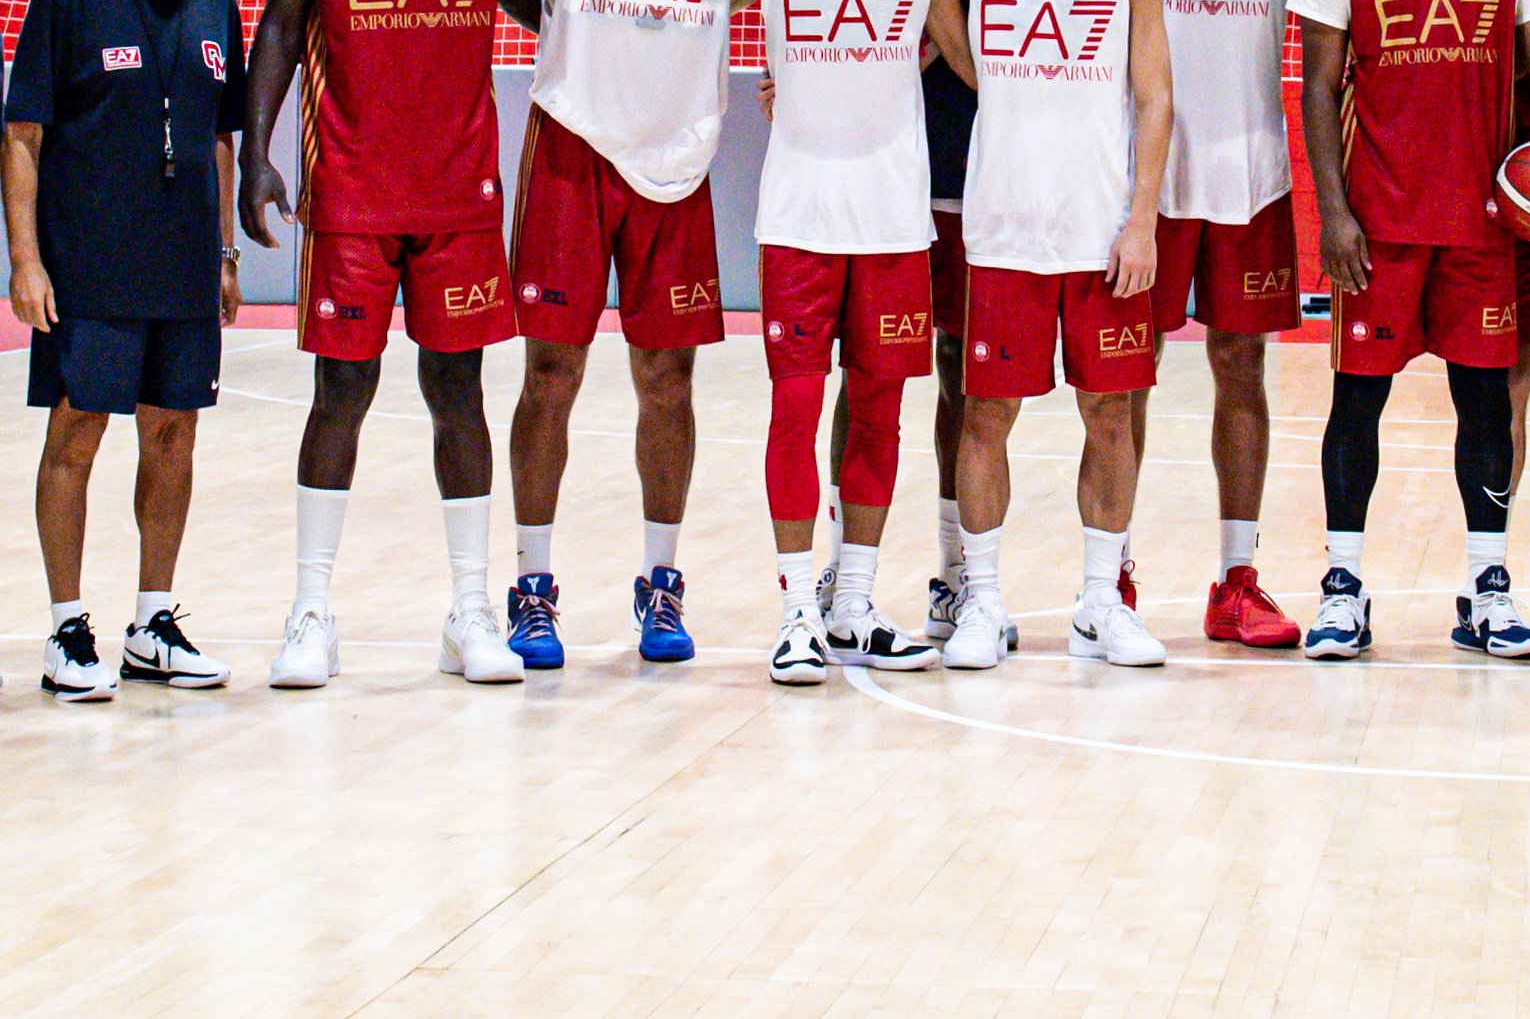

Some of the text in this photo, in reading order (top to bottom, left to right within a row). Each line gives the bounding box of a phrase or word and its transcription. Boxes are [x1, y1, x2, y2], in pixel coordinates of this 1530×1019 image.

[1221, 0, 1269, 17] ARMANI
[350, 11, 491, 31] EMPORIO ARMANI
[105, 48, 138, 63] EA7
[785, 47, 848, 63] EMPORIO
[1378, 48, 1441, 67] EMPORIO
[981, 61, 1114, 82] EMPORIO ARMANI
[1244, 268, 1291, 293] EA7
[445, 276, 499, 310] EA7
[880, 313, 927, 337] EA7
[1100, 323, 1148, 351] EA7
